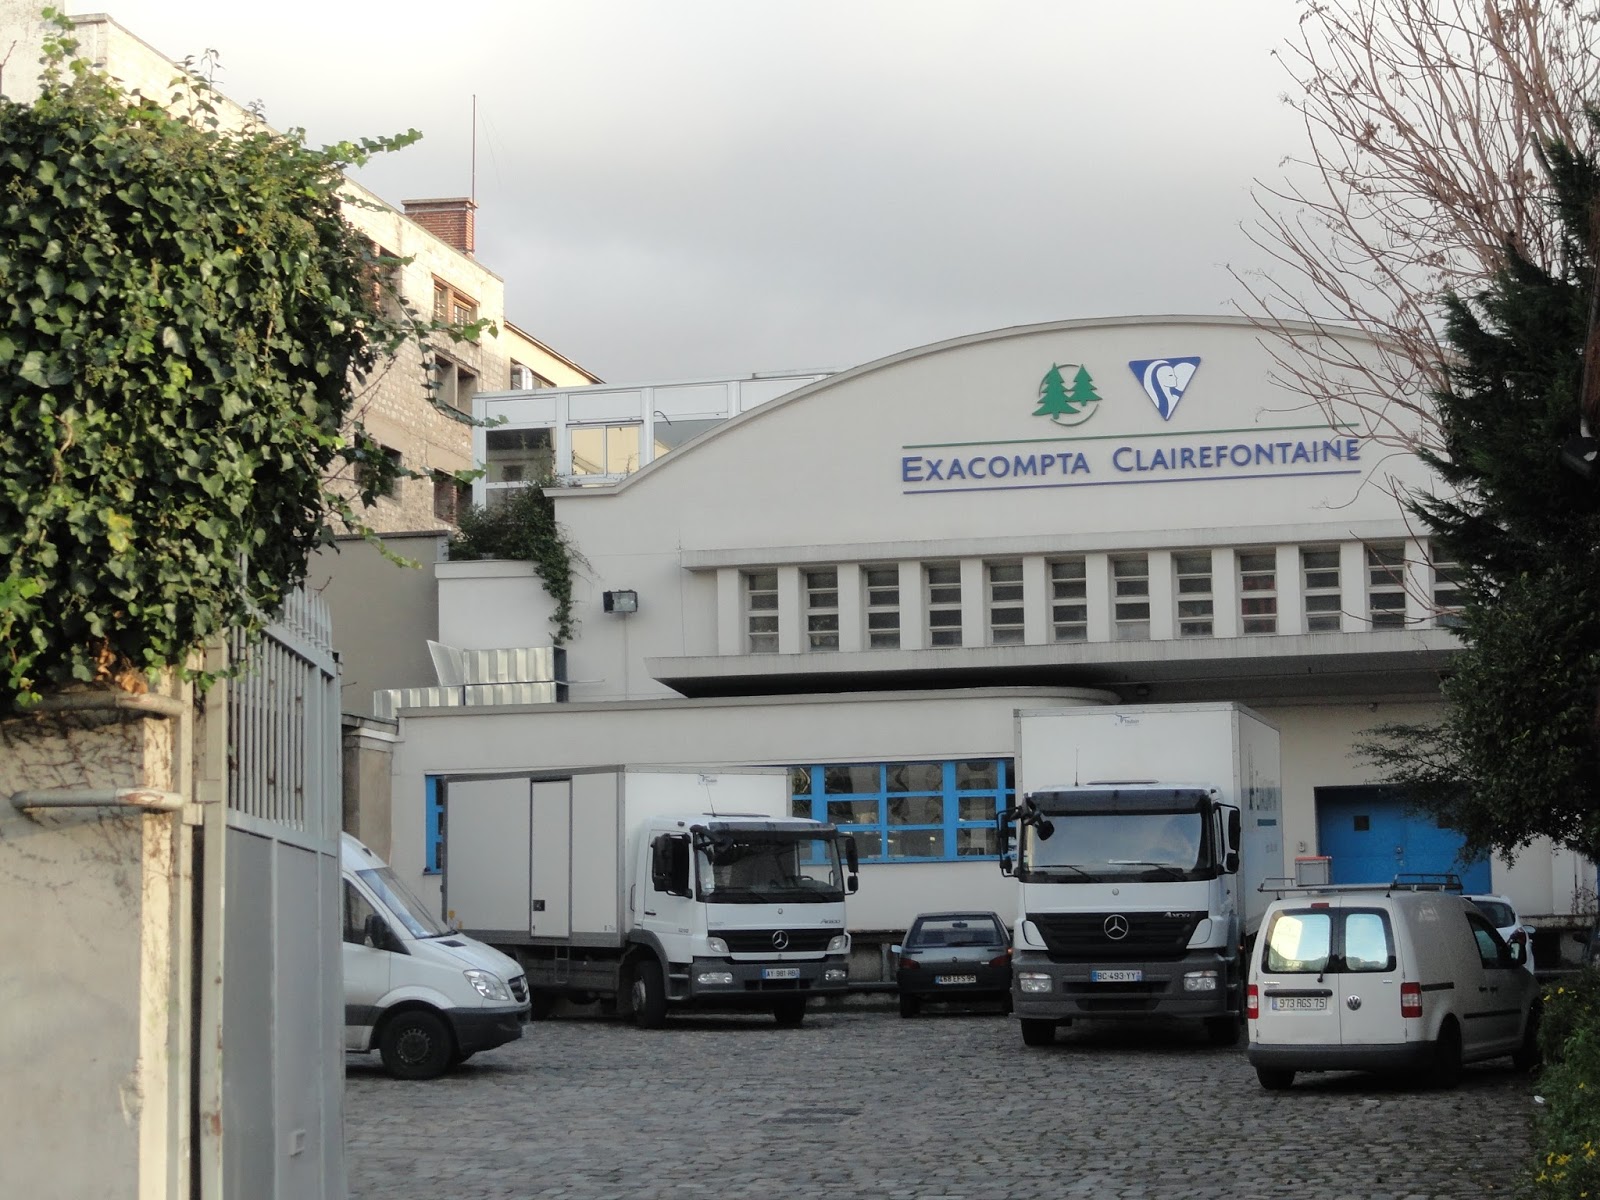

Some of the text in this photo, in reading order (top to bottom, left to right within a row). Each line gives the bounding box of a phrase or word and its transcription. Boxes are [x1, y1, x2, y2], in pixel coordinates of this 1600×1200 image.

[902, 438, 1361, 482] EXACOMPTA CLAIREFONTAINE
[1279, 998, 1295, 1008] 973
[1313, 998, 1325, 1008] 75
